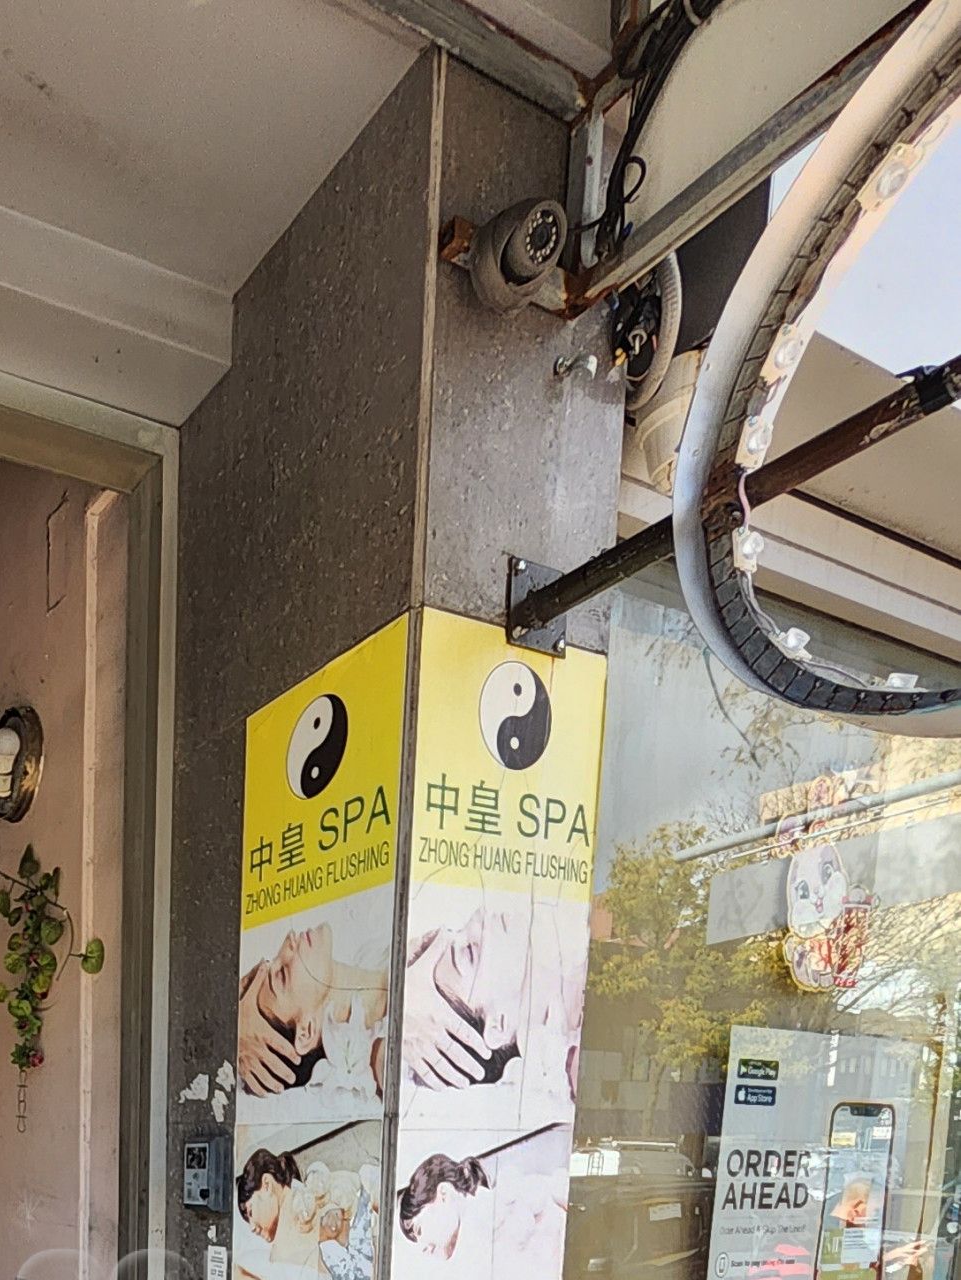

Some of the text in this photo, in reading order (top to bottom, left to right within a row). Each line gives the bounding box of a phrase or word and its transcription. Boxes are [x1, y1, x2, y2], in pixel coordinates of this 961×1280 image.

[249, 785, 391, 882] 中皇 SPA
[426, 773, 590, 847] 中皇 SPA
[245, 840, 390, 915] ZHONG HUANG FLUSHING
[419, 836, 588, 885] ZHONG HUANG FLUSHING
[726, 1149, 811, 1178] ORDER
[721, 1181, 809, 1210] AHEAD
